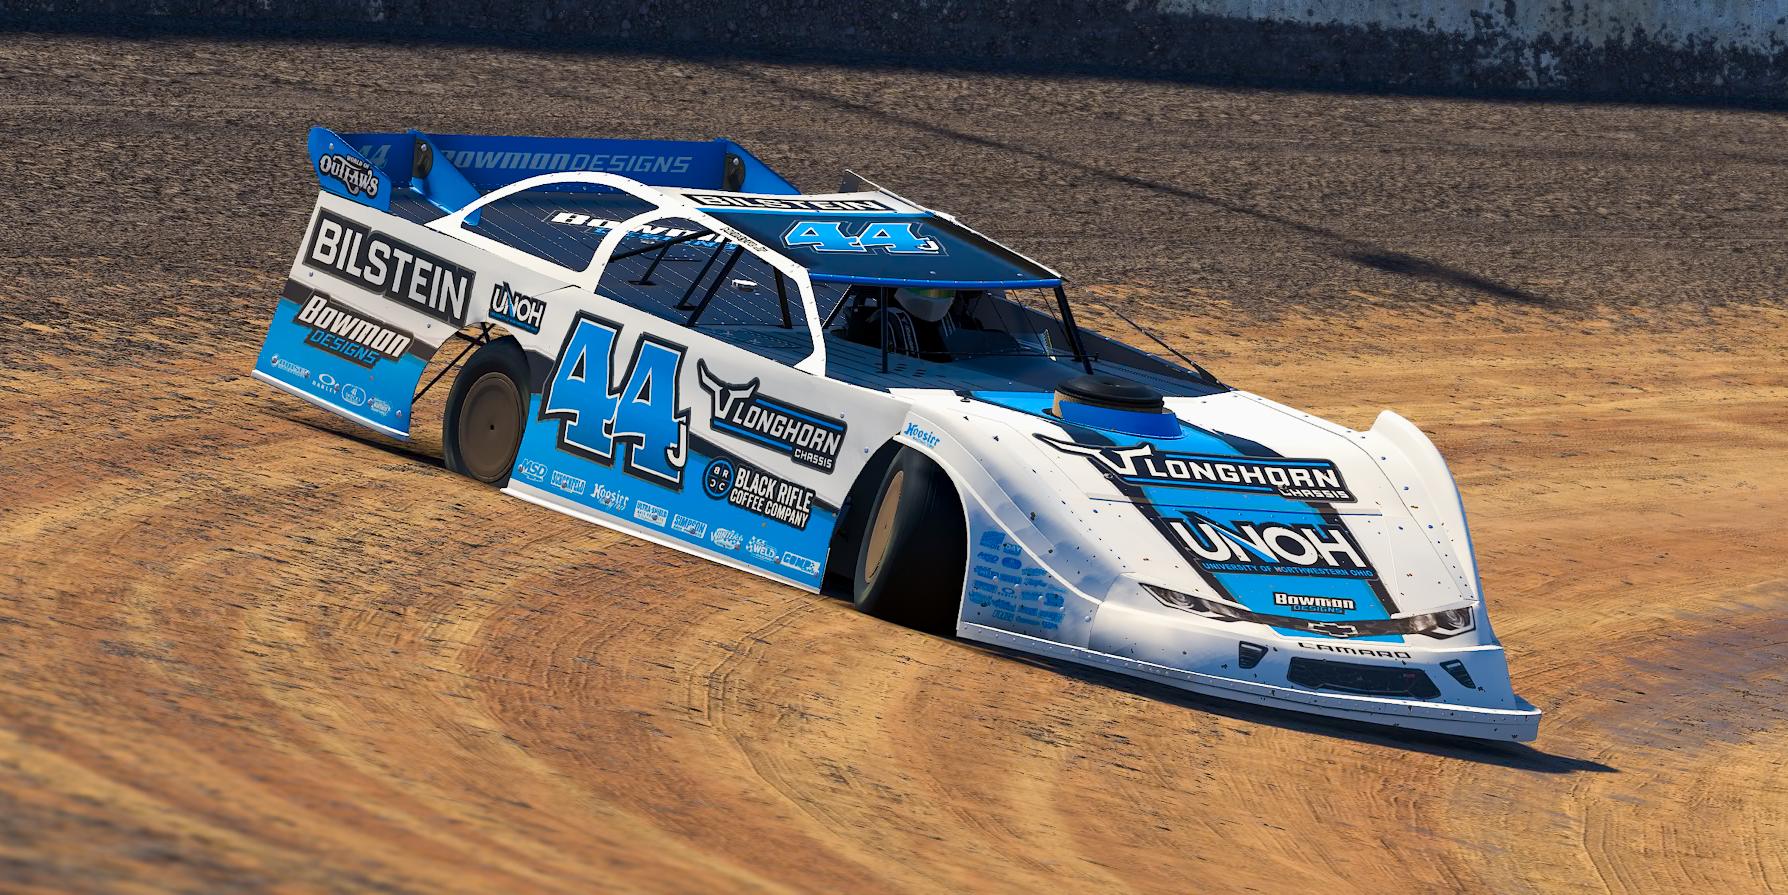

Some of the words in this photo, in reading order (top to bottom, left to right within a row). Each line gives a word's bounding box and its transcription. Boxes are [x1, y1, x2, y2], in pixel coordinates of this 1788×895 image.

[699, 194, 885, 211] BILSTEIN
[311, 218, 468, 320] BILSTEIN
[492, 285, 544, 328] UNOH
[298, 294, 411, 358] Bowman
[309, 329, 381, 366] DESIGNS
[541, 313, 688, 490] 44
[732, 401, 842, 457] LONGHORN
[521, 458, 548, 478] MSD
[794, 448, 834, 469] CHASSIS
[1144, 458, 1341, 489] LONGHORN
[734, 467, 778, 500] BLACK
[777, 482, 815, 513] RIFLE
[1280, 488, 1350, 499] CHASSIS
[730, 488, 764, 513] COFFEE
[764, 500, 809, 528] COMPANY
[753, 543, 776, 558] WELD
[1170, 516, 1367, 568] UNOH
[1202, 562, 1258, 572] UNIVERSITY
[1260, 565, 1273, 573] OF
[1274, 566, 1350, 576] NORTHWESTERN
[1350, 569, 1374, 578] OHIO
[1275, 592, 1354, 609] Bowman
[1293, 605, 1343, 614] DESIGNS
[1298, 642, 1412, 659] CAMARO
